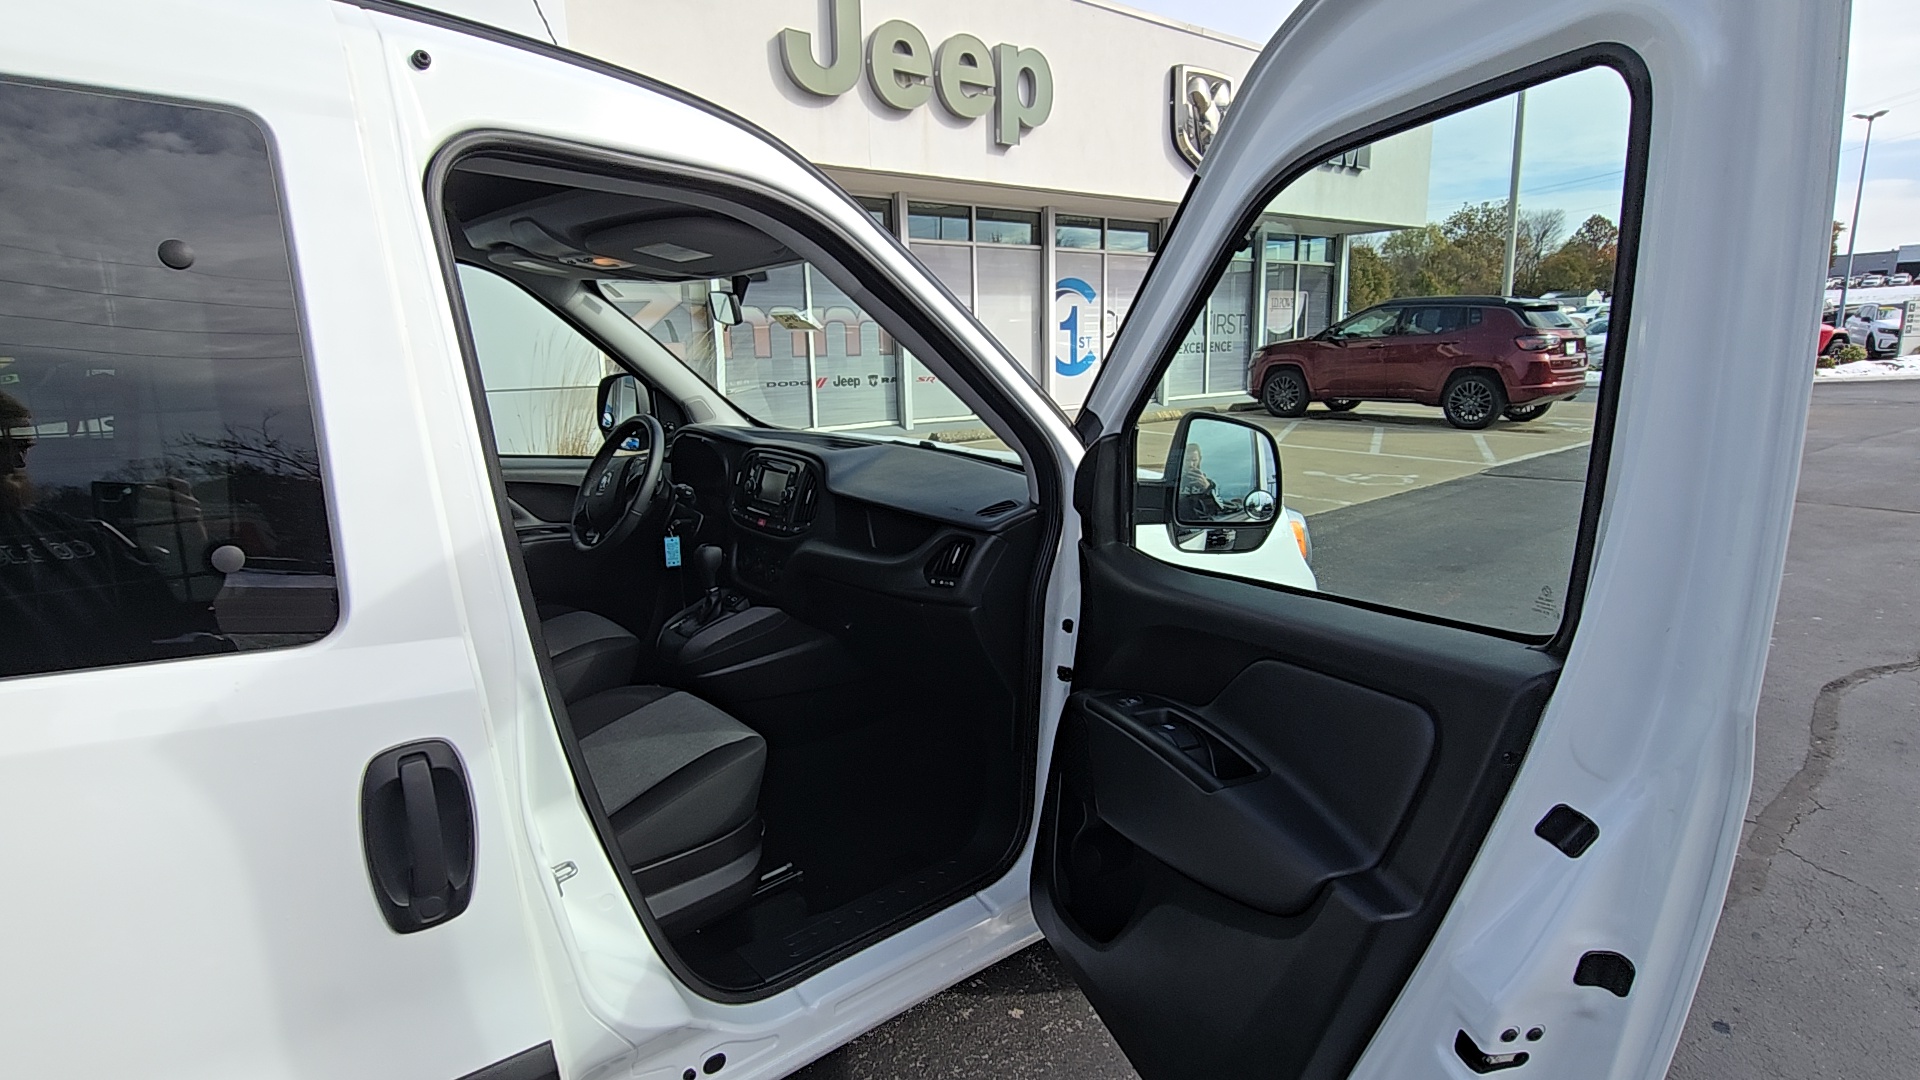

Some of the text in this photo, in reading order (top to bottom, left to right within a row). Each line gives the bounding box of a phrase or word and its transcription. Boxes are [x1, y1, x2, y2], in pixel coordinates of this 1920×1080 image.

[778, 0, 1054, 145] Jeep
[1204, 311, 1246, 336] IRST
[833, 375, 861, 388] Jeep
[917, 376, 935, 384] SR
